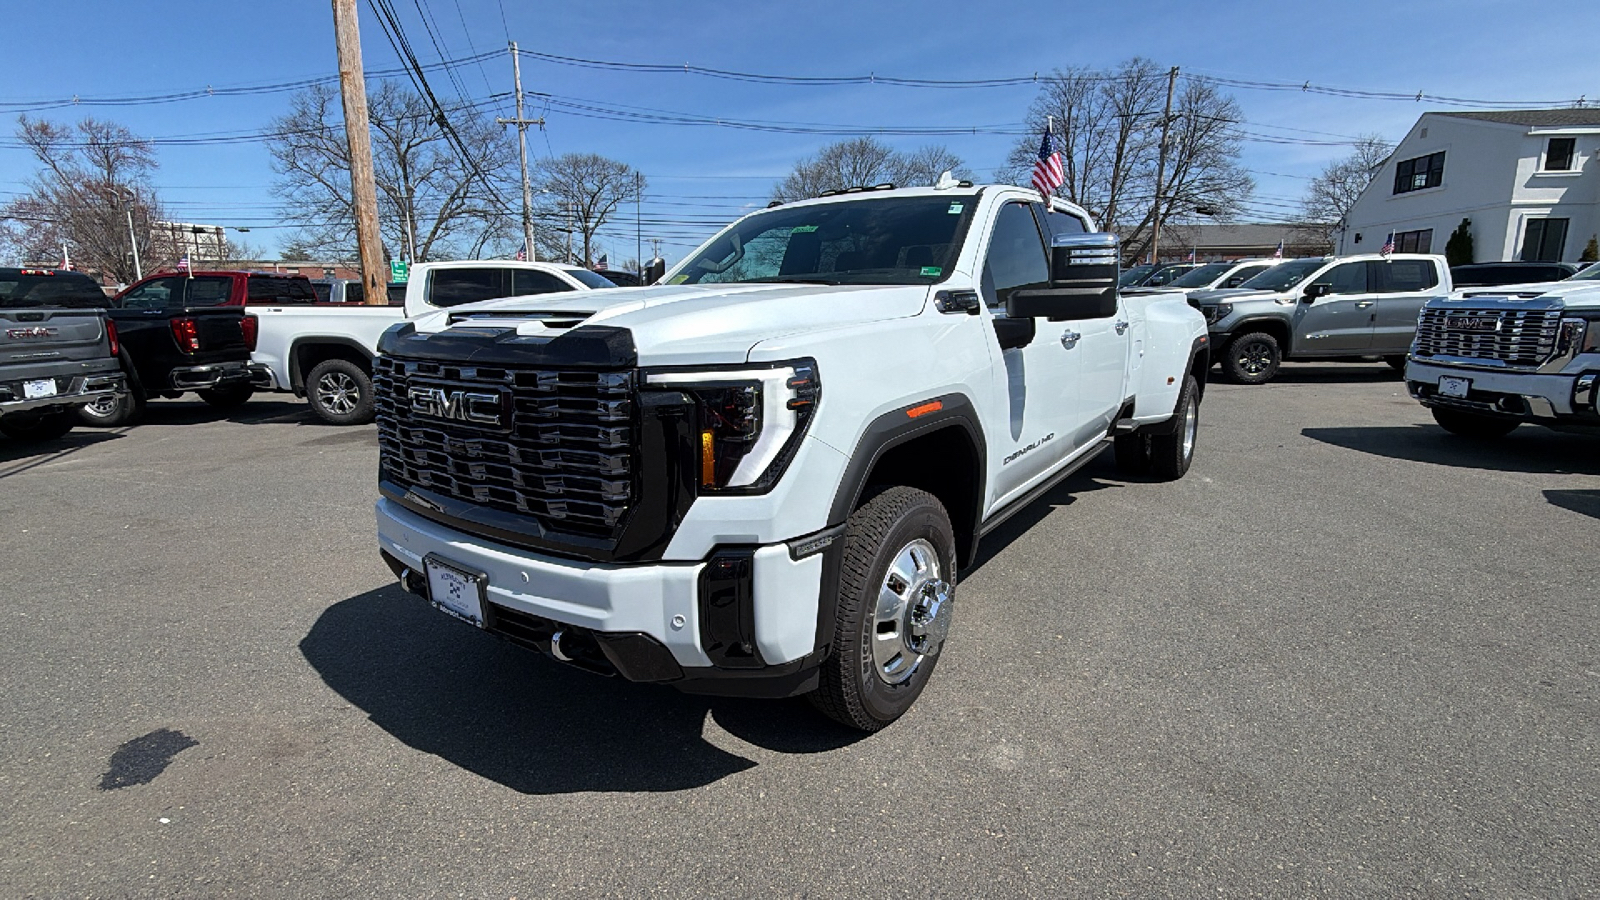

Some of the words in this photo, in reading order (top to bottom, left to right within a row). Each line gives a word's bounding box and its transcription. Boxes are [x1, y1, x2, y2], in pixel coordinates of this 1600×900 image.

[1447, 317, 1497, 329] GMC
[408, 386, 500, 425] GMC
[1003, 440, 1040, 466] DENALI
[1041, 433, 1055, 444] HD
